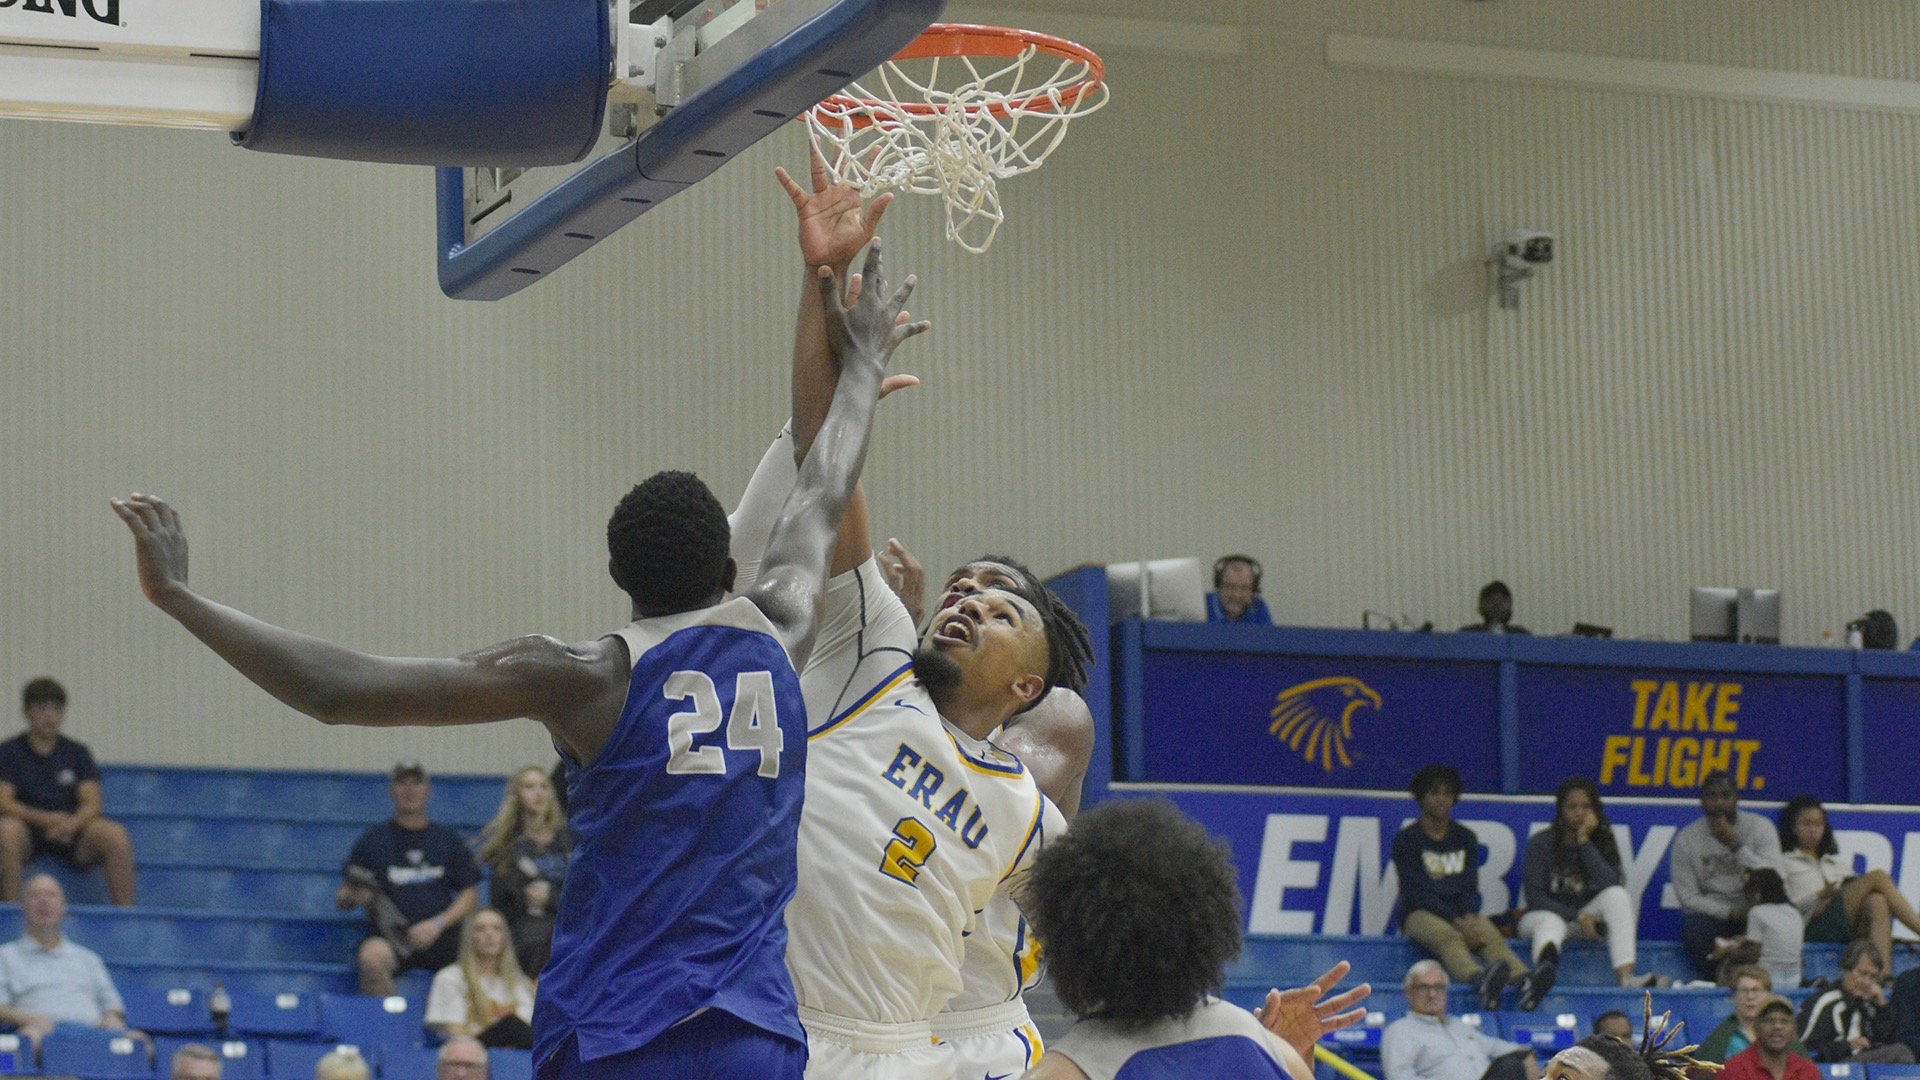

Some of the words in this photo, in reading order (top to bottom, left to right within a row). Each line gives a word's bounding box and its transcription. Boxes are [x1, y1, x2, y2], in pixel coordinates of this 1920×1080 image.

[663, 670, 783, 779] 24
[1631, 680, 1743, 732] TAKE
[881, 741, 988, 850] ERAU
[1600, 735, 1767, 790] FLIGHT.
[878, 816, 937, 889] 2
